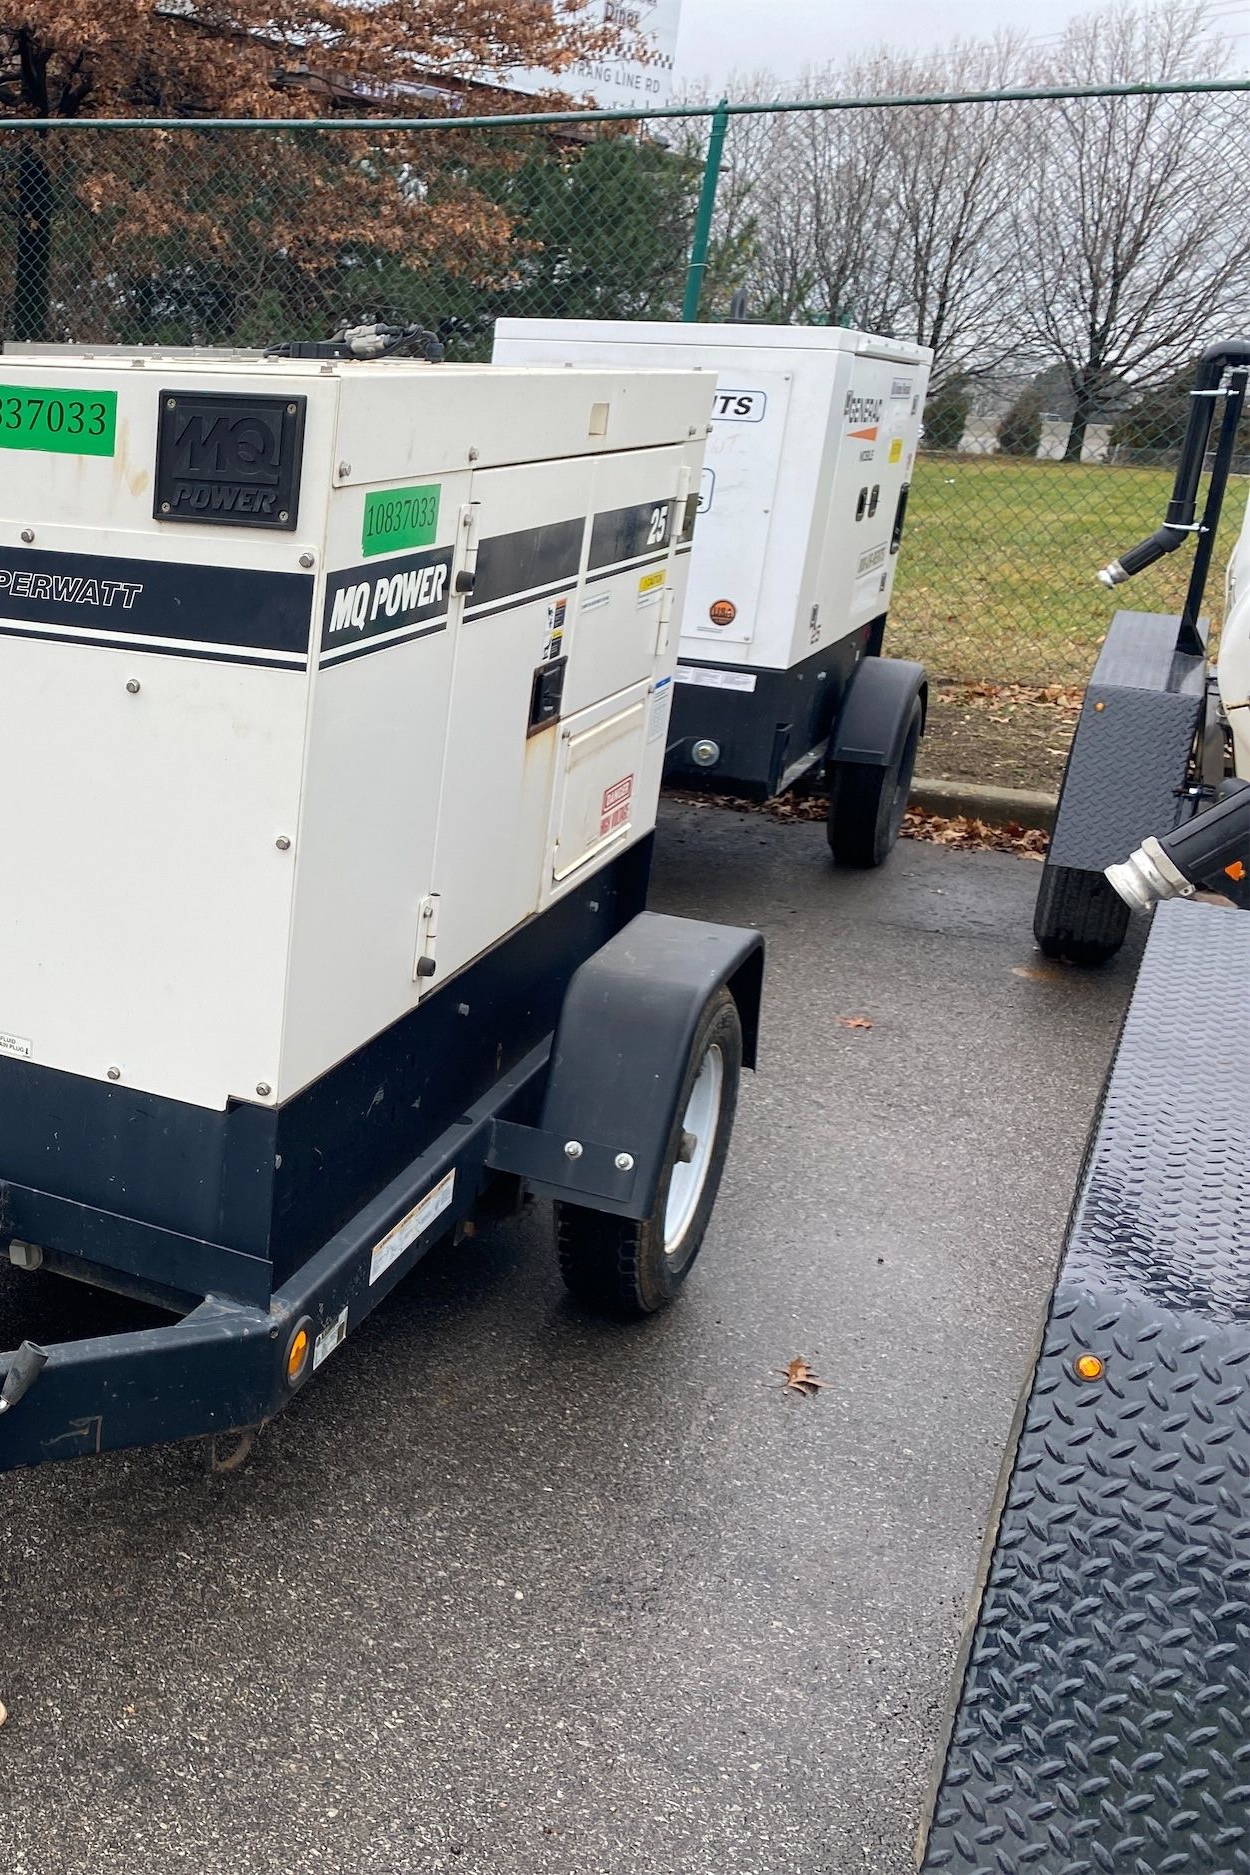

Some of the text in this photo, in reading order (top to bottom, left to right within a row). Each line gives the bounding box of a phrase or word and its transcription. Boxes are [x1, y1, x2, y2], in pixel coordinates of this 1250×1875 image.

[615, 69, 642, 90] LINE
[645, 77, 661, 94] RD
[174, 415, 279, 475] MQ
[173, 482, 277, 513] POWER
[366, 496, 436, 537] 10837033
[646, 504, 668, 545] 25
[329, 563, 448, 632] MQ POWER
